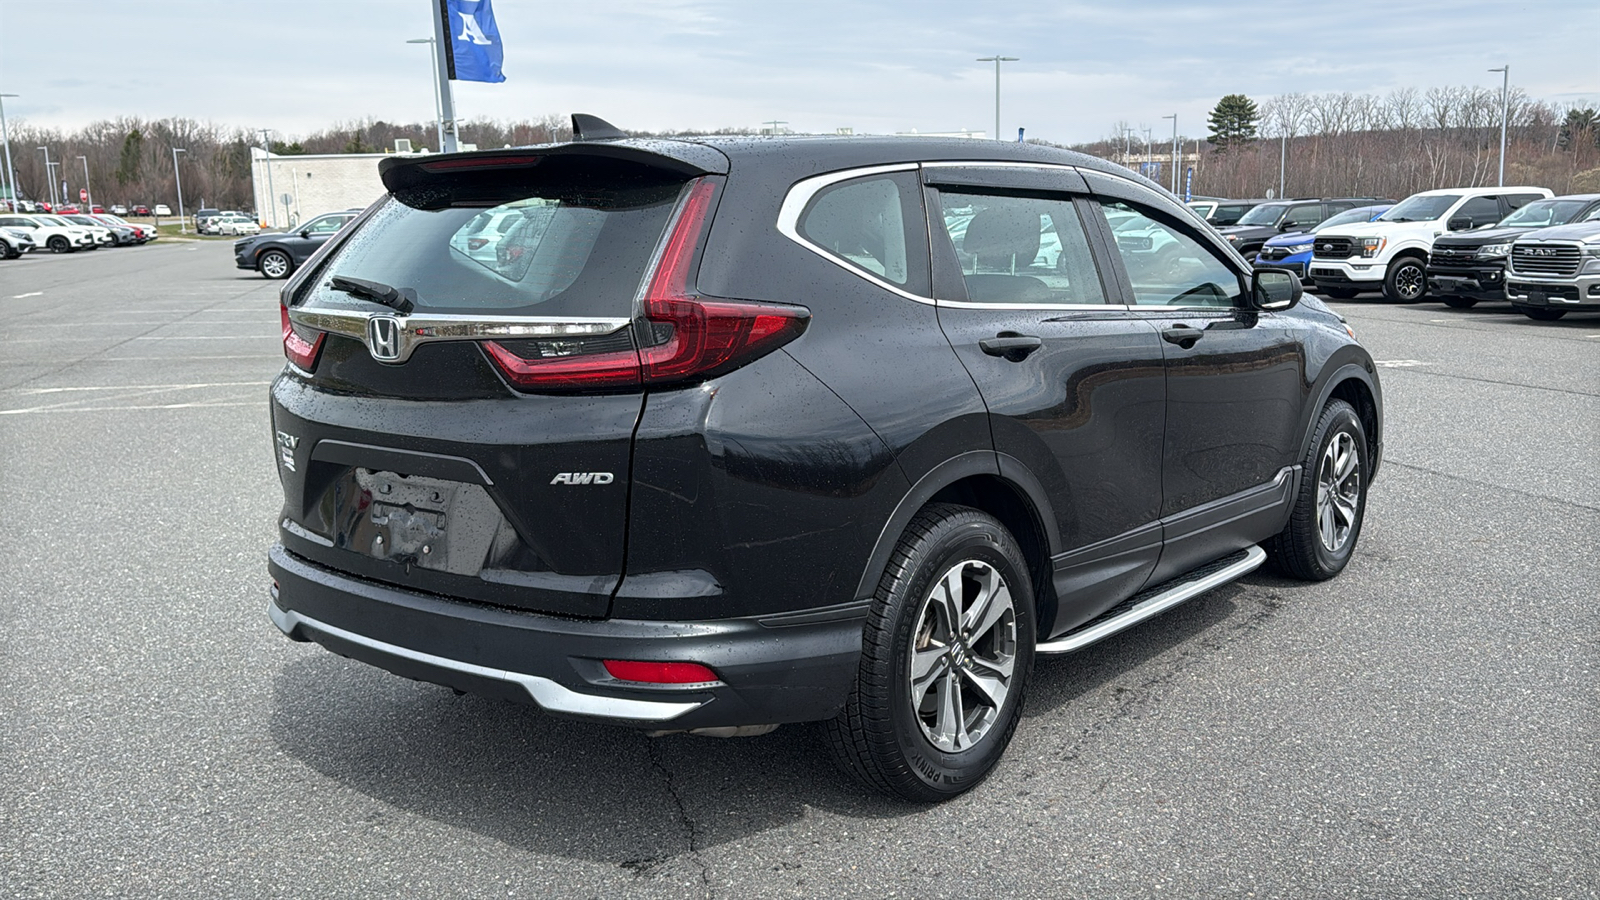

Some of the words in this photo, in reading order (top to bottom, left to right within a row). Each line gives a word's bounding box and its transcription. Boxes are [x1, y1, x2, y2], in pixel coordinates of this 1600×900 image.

[457, 11, 493, 45] A
[1523, 247, 1557, 256] RAM
[549, 472, 614, 485] AWD
[910, 750, 942, 783] PRINX
